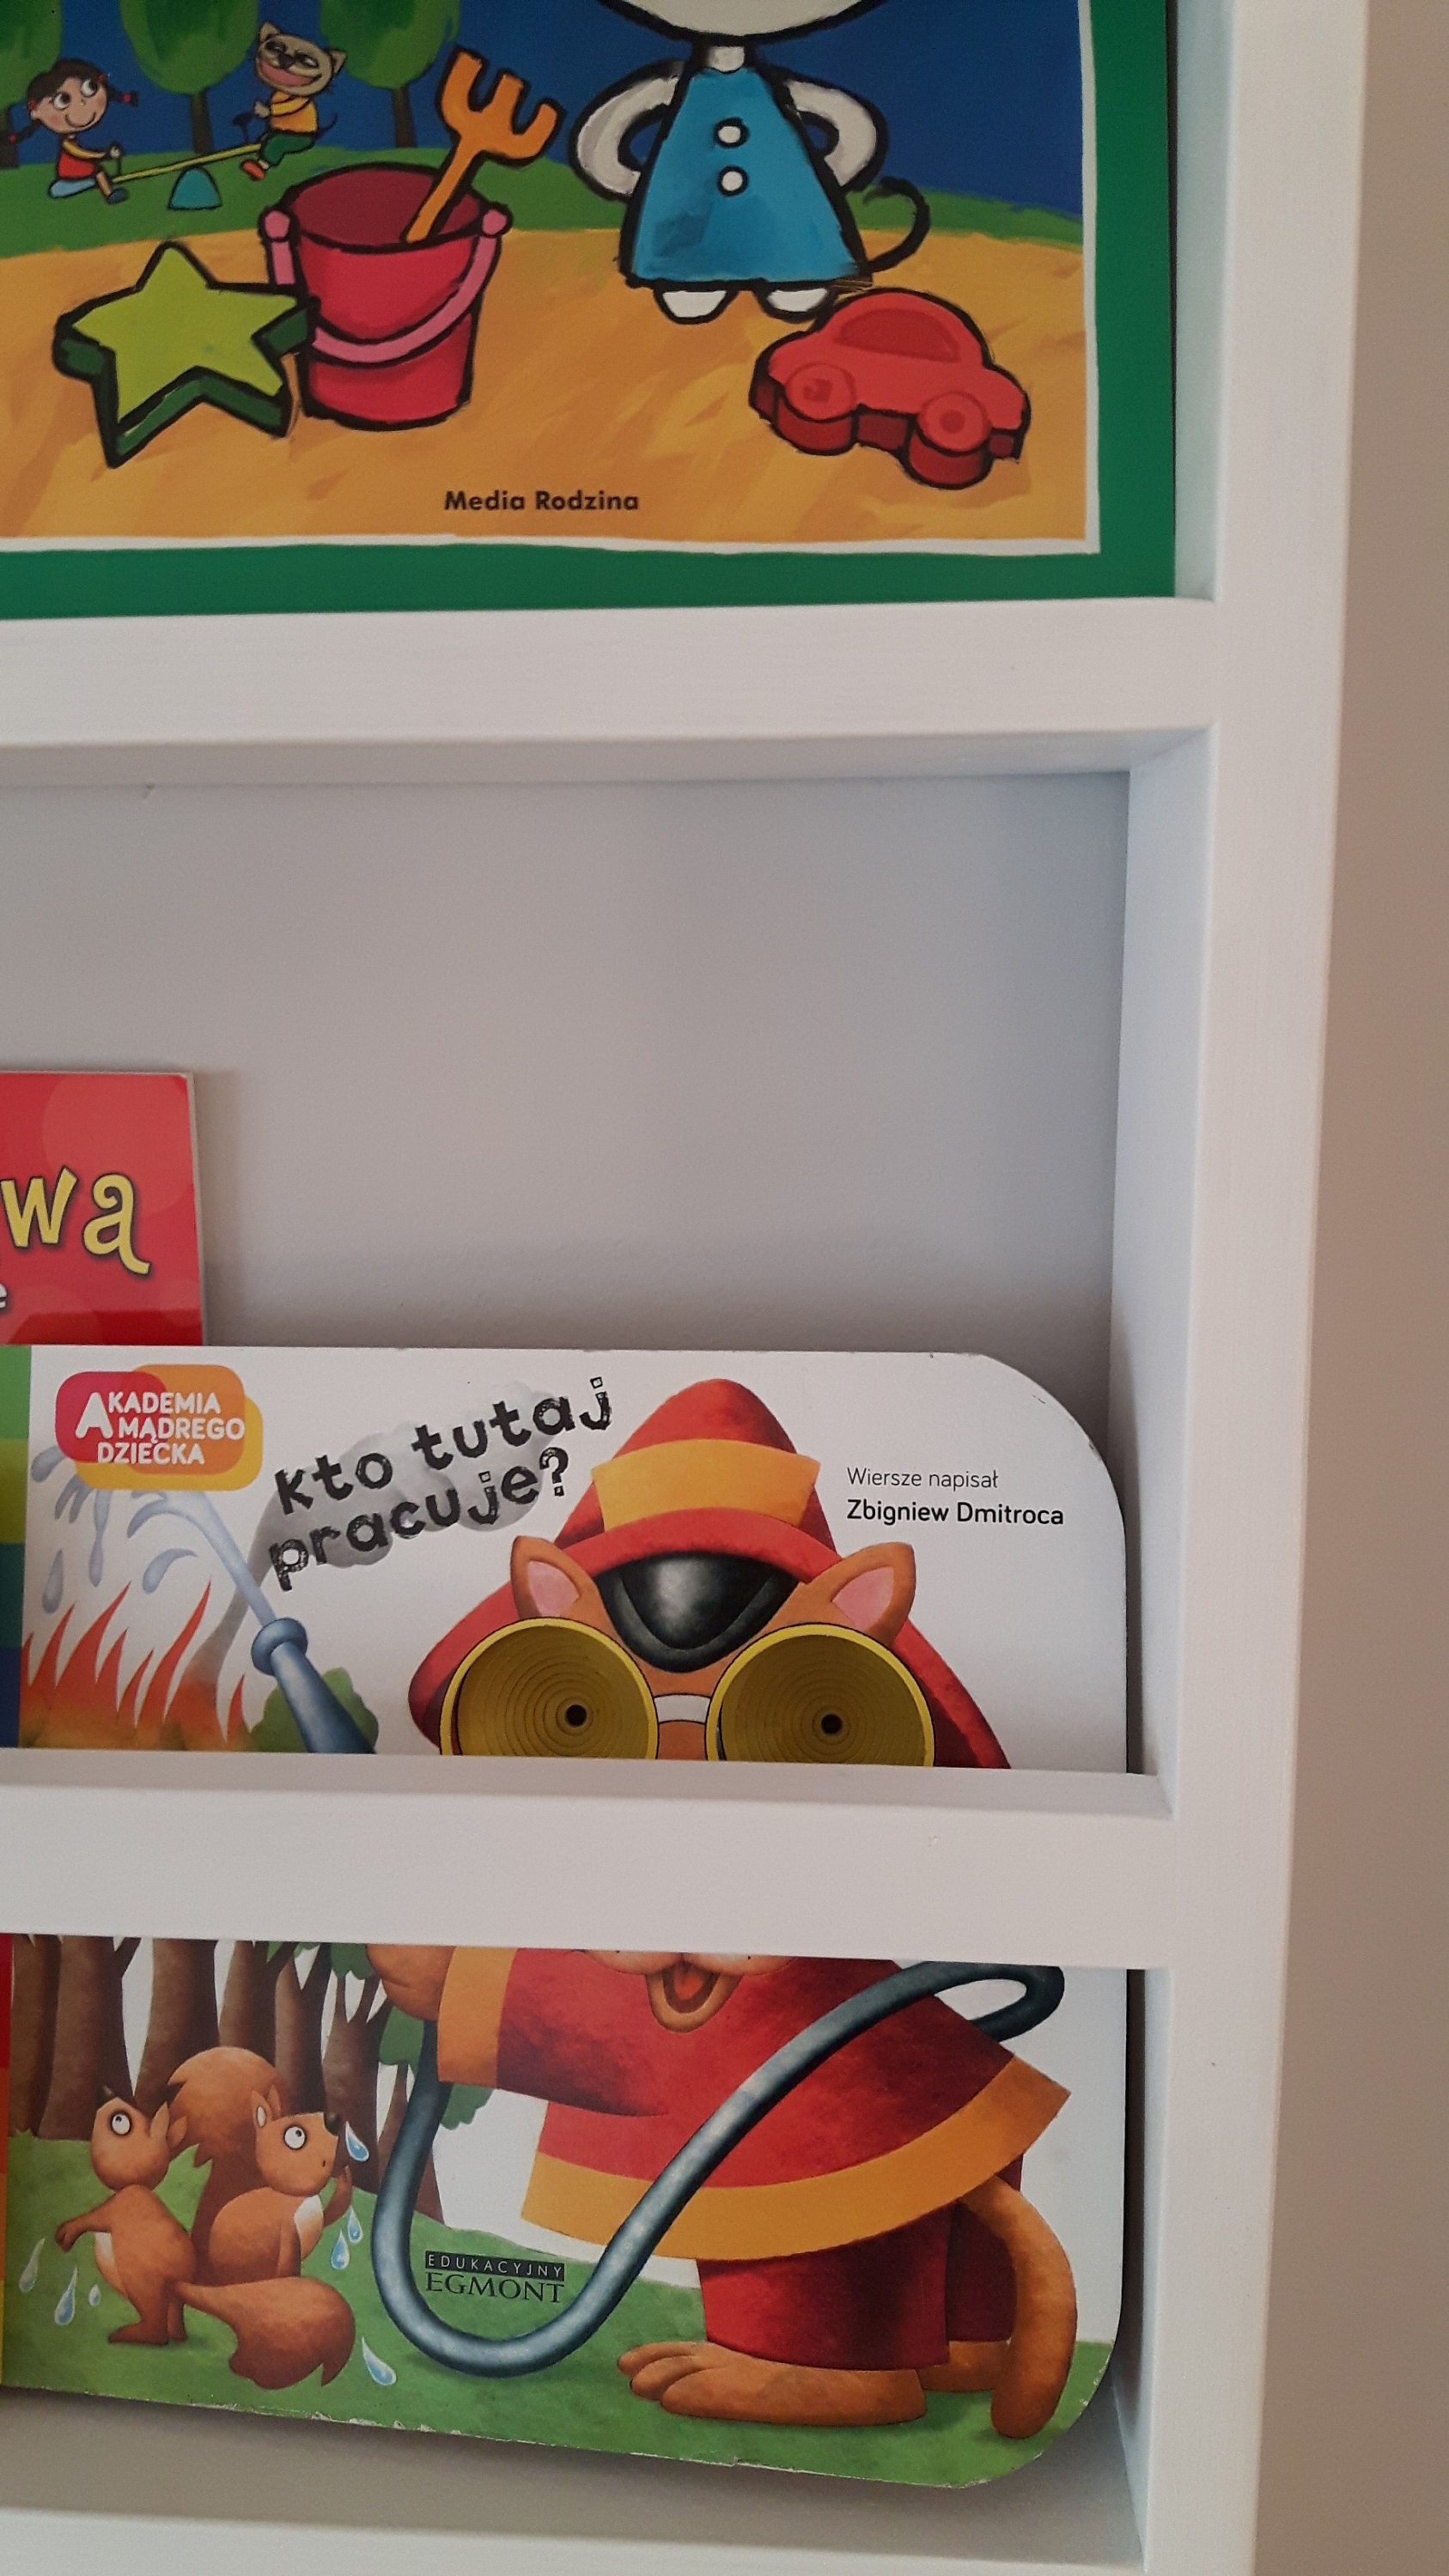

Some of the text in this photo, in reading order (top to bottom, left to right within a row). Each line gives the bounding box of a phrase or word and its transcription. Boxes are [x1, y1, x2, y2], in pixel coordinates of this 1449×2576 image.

[444, 489, 639, 510] Media Rodzina
[76, 1392, 222, 1439] AKADEMIA
[119, 1417, 246, 1443] MĄDREGO
[97, 1442, 205, 1465] DZIECKA
[273, 1376, 612, 1515] kto tutaj
[846, 1467, 999, 1492] Wiersze napisał
[268, 1446, 569, 1592] pracuje?
[846, 1498, 1064, 1526] Zbigniew Dmitroca
[428, 2254, 562, 2278] EDUKACYJNY
[425, 2272, 565, 2304] EGMONT
